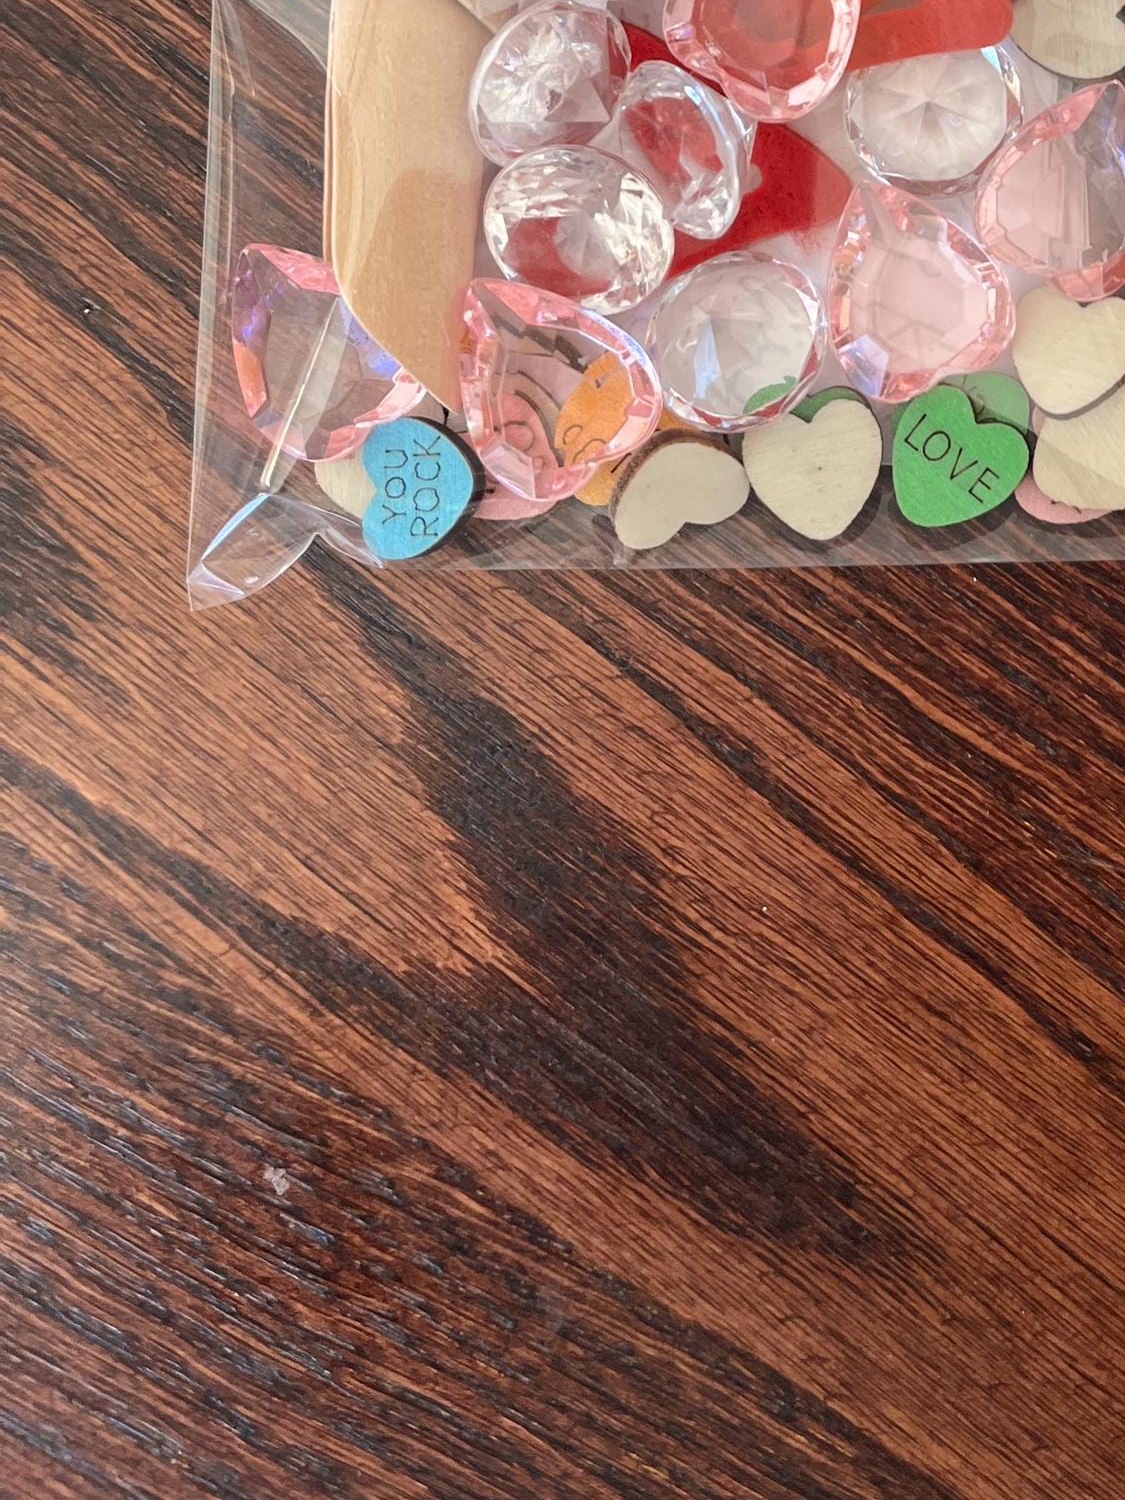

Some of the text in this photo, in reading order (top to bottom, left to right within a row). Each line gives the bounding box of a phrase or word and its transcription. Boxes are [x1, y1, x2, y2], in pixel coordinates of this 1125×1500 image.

[382, 449, 408, 523] YOU
[410, 435, 441, 537] ROCK
[904, 413, 1000, 503] LOVE
